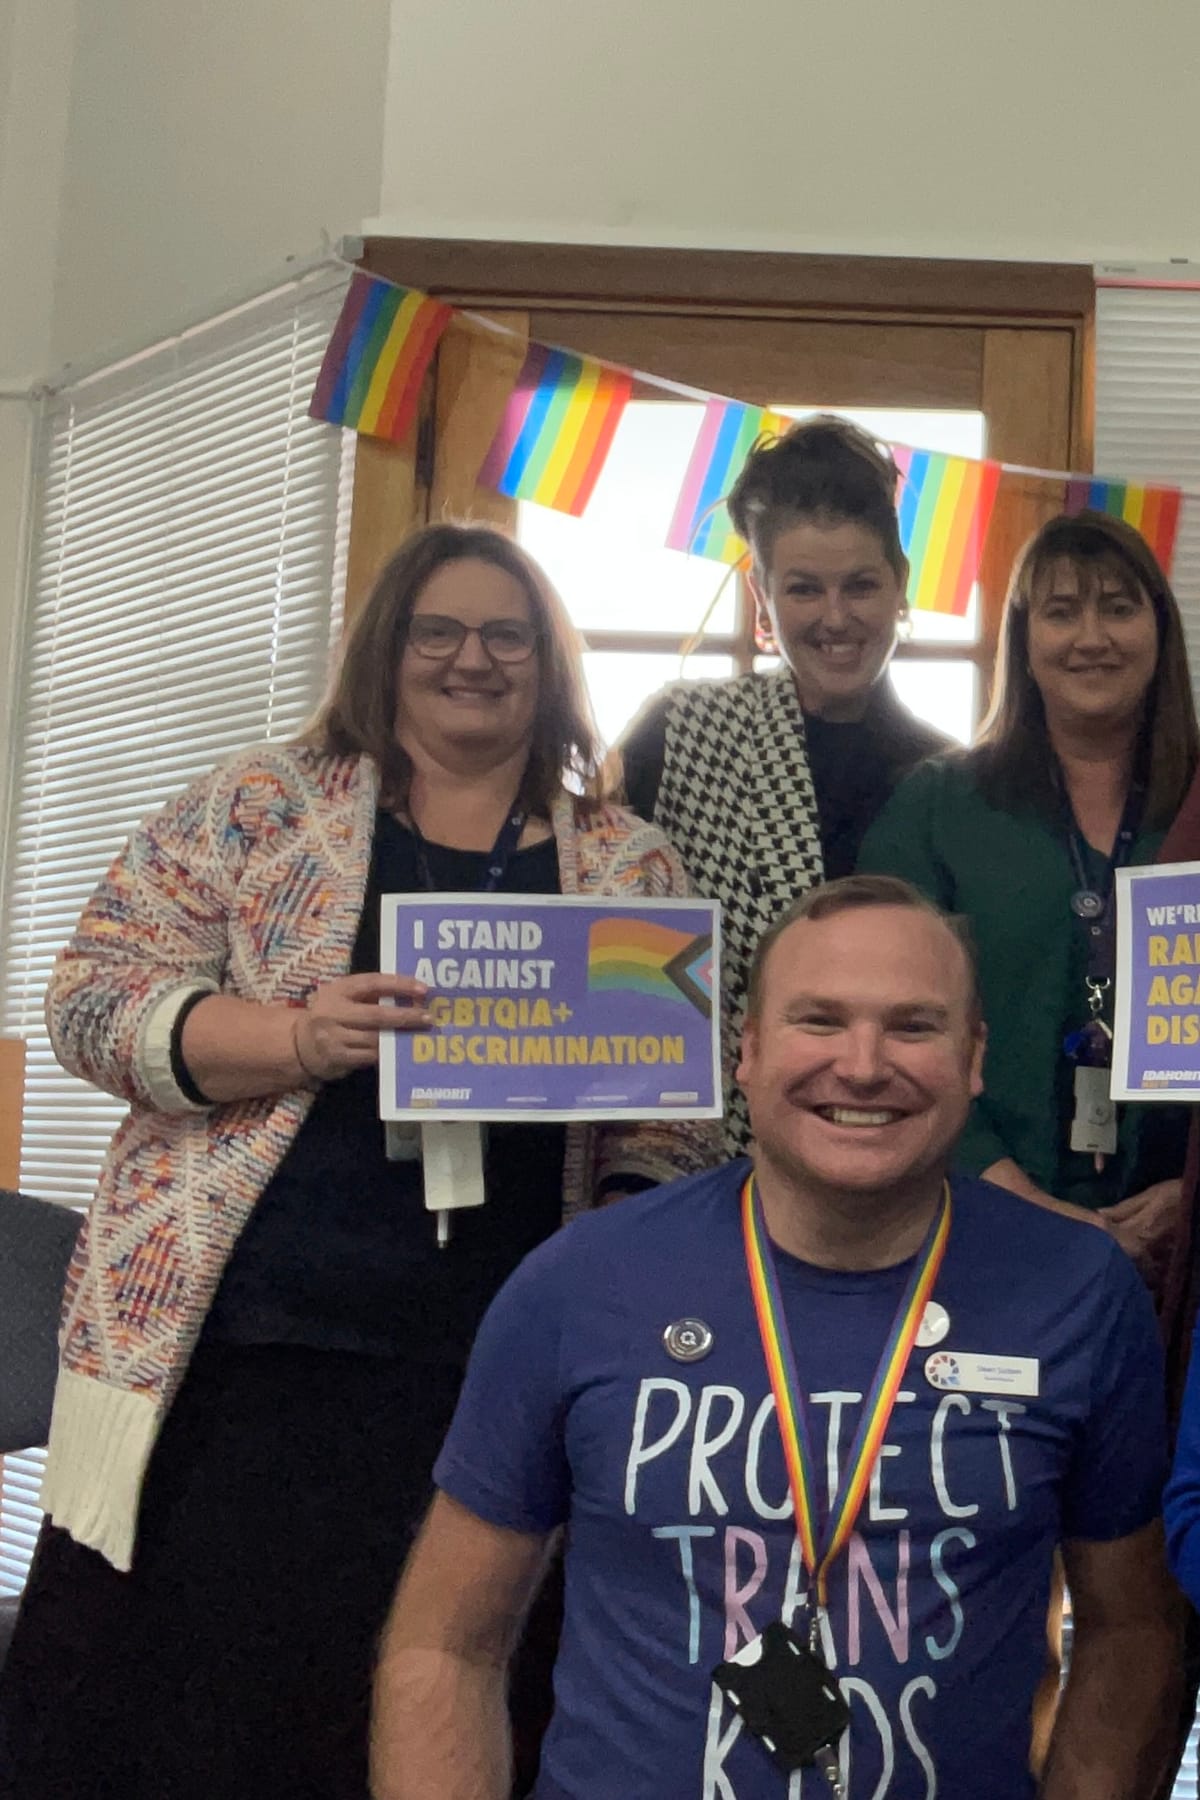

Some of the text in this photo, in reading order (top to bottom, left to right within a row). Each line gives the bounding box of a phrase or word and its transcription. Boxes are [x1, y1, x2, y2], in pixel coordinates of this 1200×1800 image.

[413, 919, 543, 951] I STAND
[414, 957, 555, 990] AGAINST
[430, 996, 574, 1029] GBTQIA+
[411, 1034, 685, 1065] DISCRIMINATION
[623, 1377, 1027, 1522] PROTECT
[651, 1525, 977, 1669] TRANS
[702, 1675, 938, 1800] KDS
